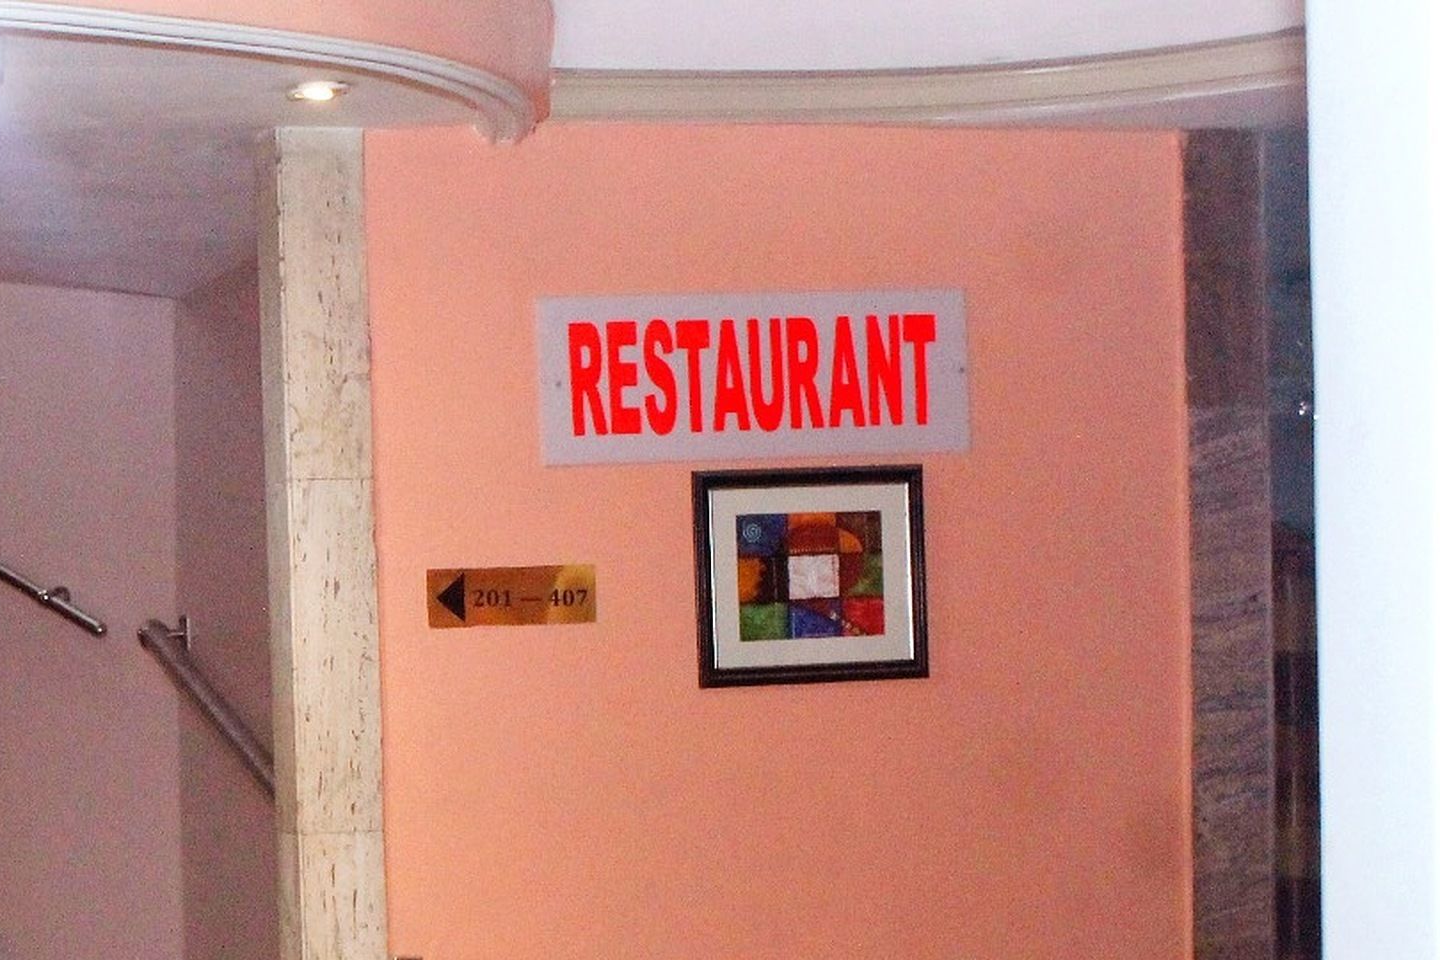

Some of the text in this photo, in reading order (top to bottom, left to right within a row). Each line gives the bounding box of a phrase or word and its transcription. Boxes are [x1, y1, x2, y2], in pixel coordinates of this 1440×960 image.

[568, 314, 936, 436] RESTAURANT
[472, 589, 512, 608] 201
[549, 589, 589, 608] 407
